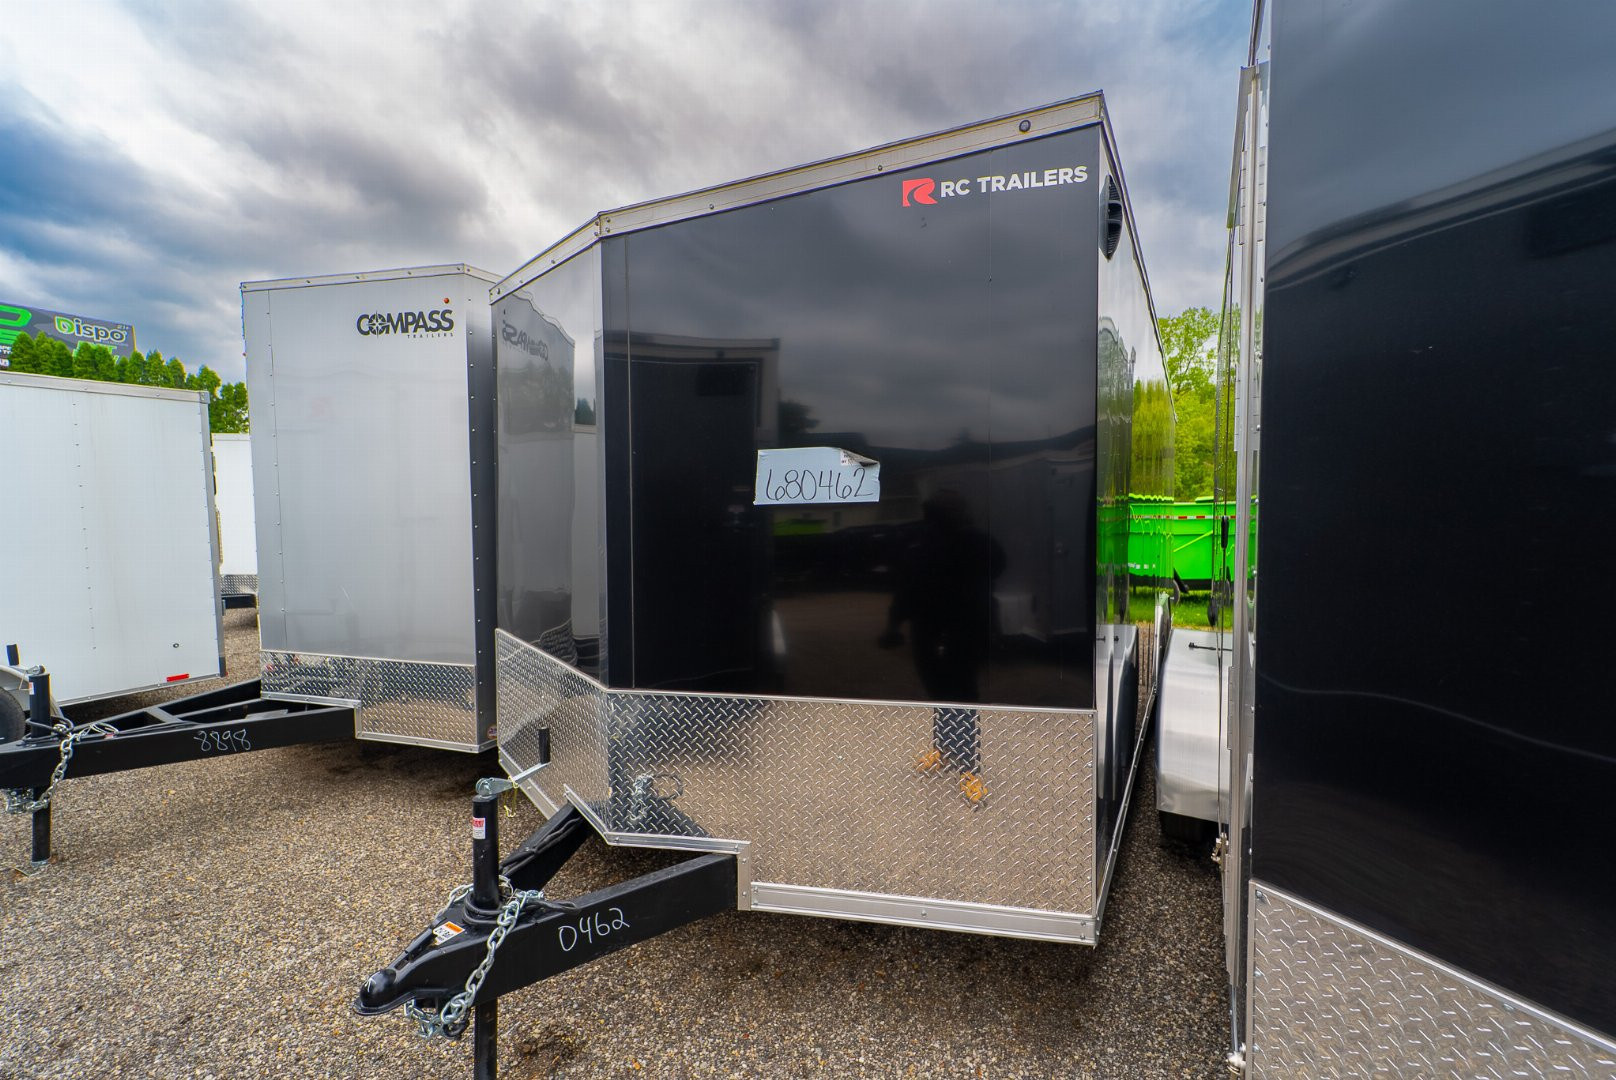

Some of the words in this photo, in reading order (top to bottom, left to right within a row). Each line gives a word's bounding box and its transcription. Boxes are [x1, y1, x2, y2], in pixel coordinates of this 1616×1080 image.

[941, 179, 970, 198] RC
[977, 165, 1088, 193] TRAILERS
[356, 309, 455, 336] COMPASS
[766, 467, 873, 501] 680462
[558, 907, 630, 952] 0462
